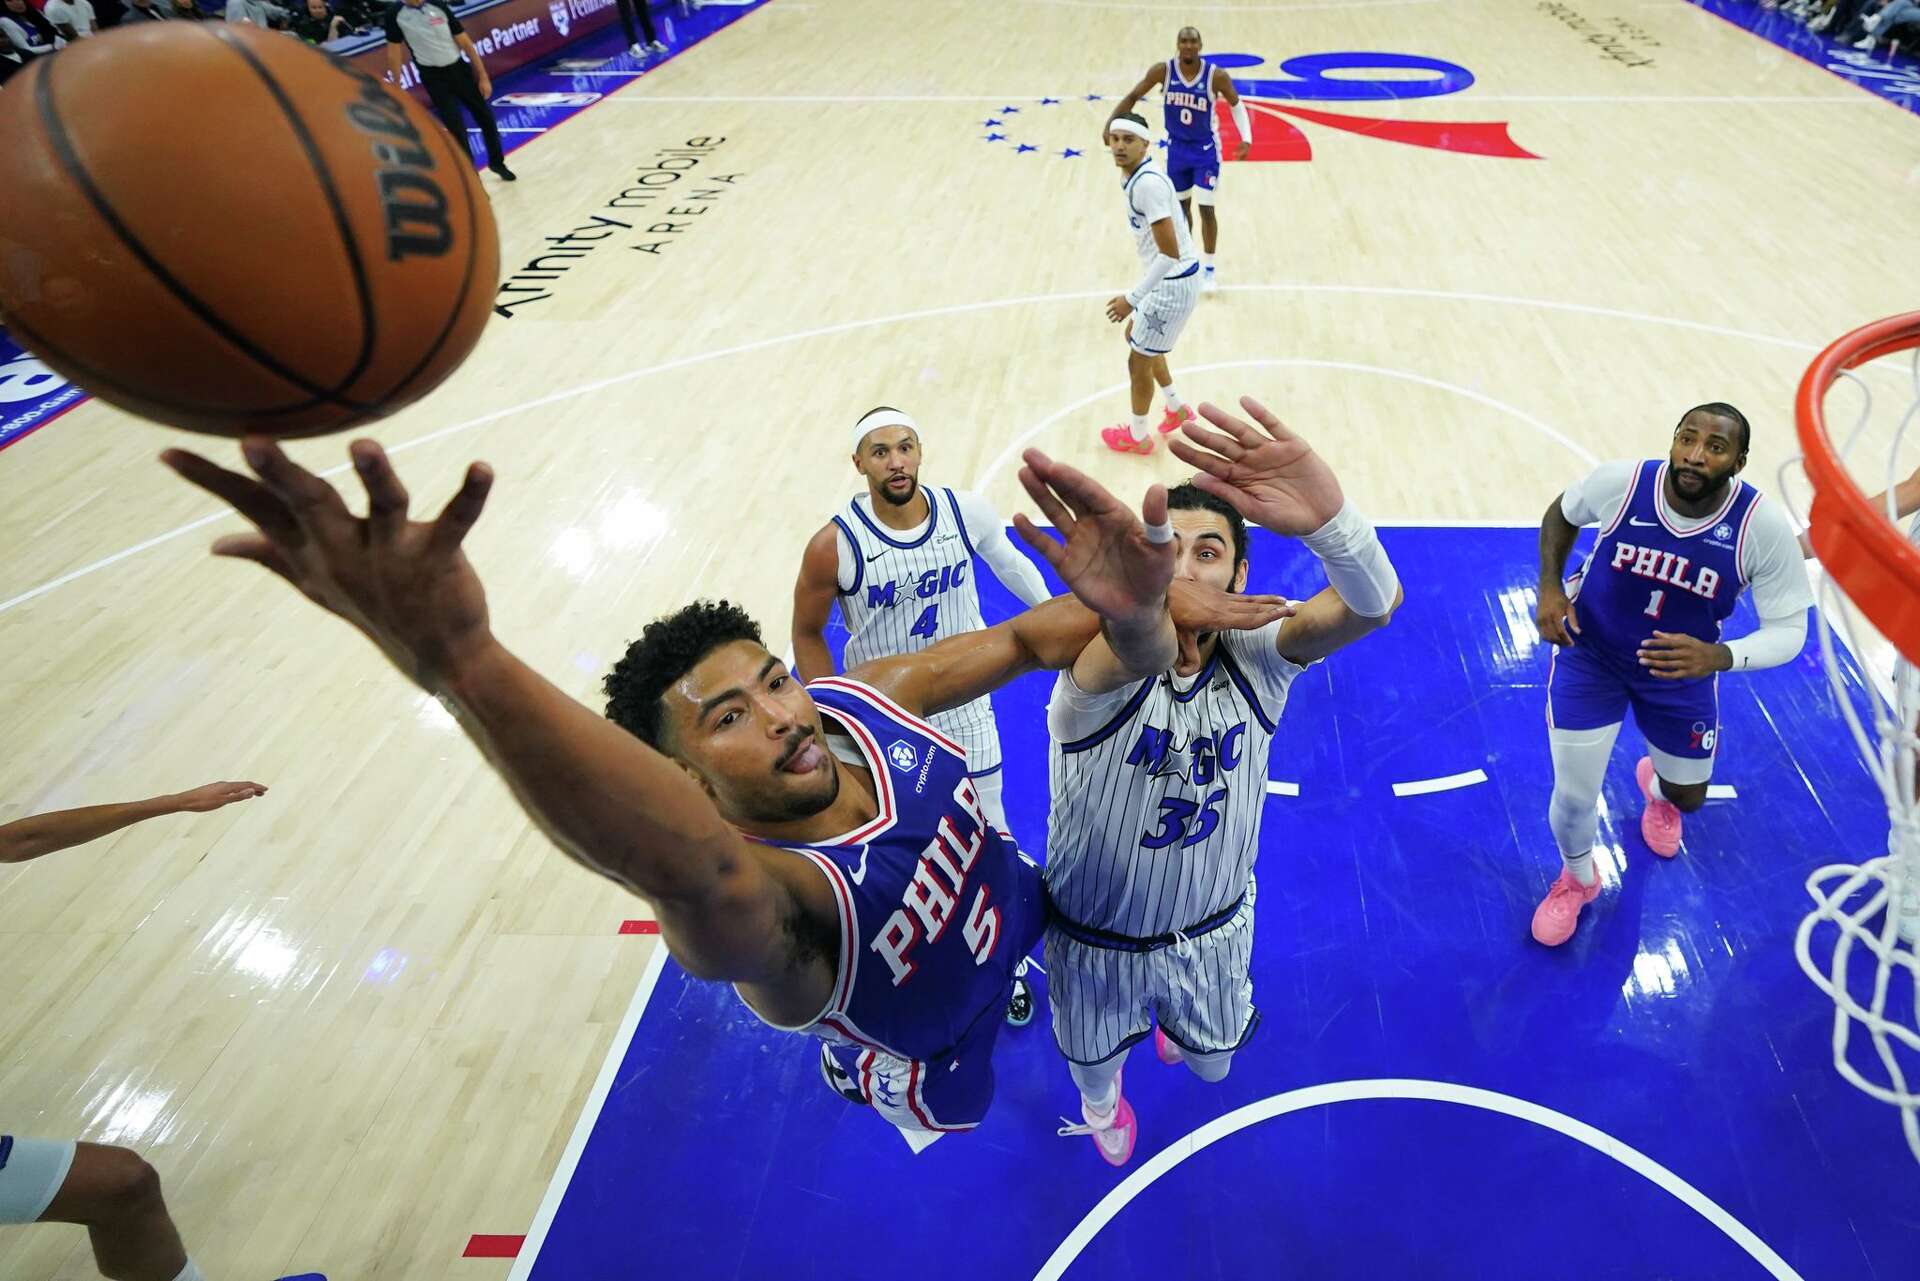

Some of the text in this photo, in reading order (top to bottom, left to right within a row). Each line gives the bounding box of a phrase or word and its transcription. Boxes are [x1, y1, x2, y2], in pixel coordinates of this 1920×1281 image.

[491, 17, 541, 50] Partner
[1166, 92, 1208, 112] PHILA
[1180, 108, 1194, 126] 0
[604, 136, 727, 208] mobile
[629, 172, 745, 255] ARENA
[1611, 542, 1721, 600] PHILA
[909, 603, 939, 639] 4
[1643, 589, 1665, 620] 1
[915, 745, 937, 794] crypto.com
[1139, 788, 1229, 850] 35
[869, 776, 986, 987] PHILA
[962, 883, 1001, 966] 5
